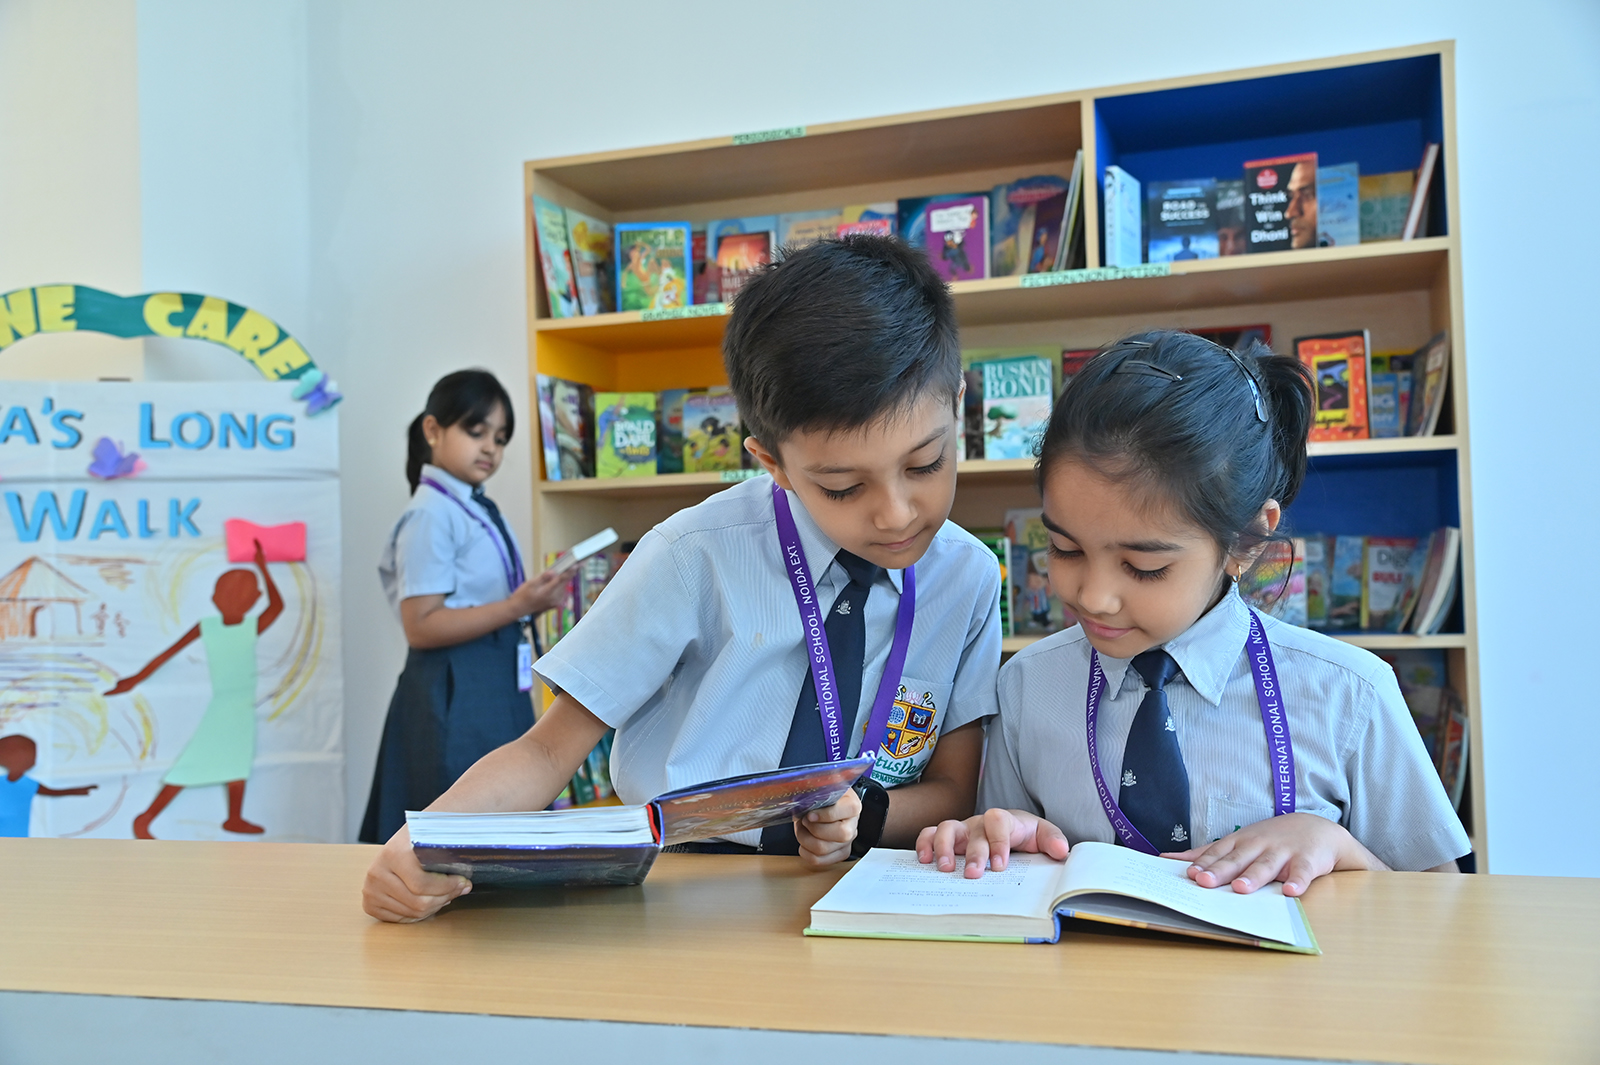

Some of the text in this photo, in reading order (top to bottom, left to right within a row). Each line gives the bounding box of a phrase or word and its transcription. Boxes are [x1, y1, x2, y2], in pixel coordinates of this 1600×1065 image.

[1250, 190, 1288, 206] Think
[1160, 207, 1210, 221] SUCCESS
[1255, 210, 1283, 224] Win
[1251, 227, 1289, 243] Dhoni
[143, 292, 312, 381] CARE
[984, 359, 1049, 381] RUSKIN
[984, 376, 1050, 399] BOND
[0, 397, 295, 450] A'S LONG
[614, 429, 656, 448] DAHL
[4, 488, 202, 543] WALK
[786, 541, 801, 566] EXT.
[794, 566, 813, 605] NOIDA
[818, 665, 842, 761] NTERNATIONAL
[875, 756, 902, 773] tus
[1267, 699, 1292, 807] INTERNATIONAL
[1096, 777, 1116, 818] NOIDA
[1114, 818, 1135, 844] EXT.
